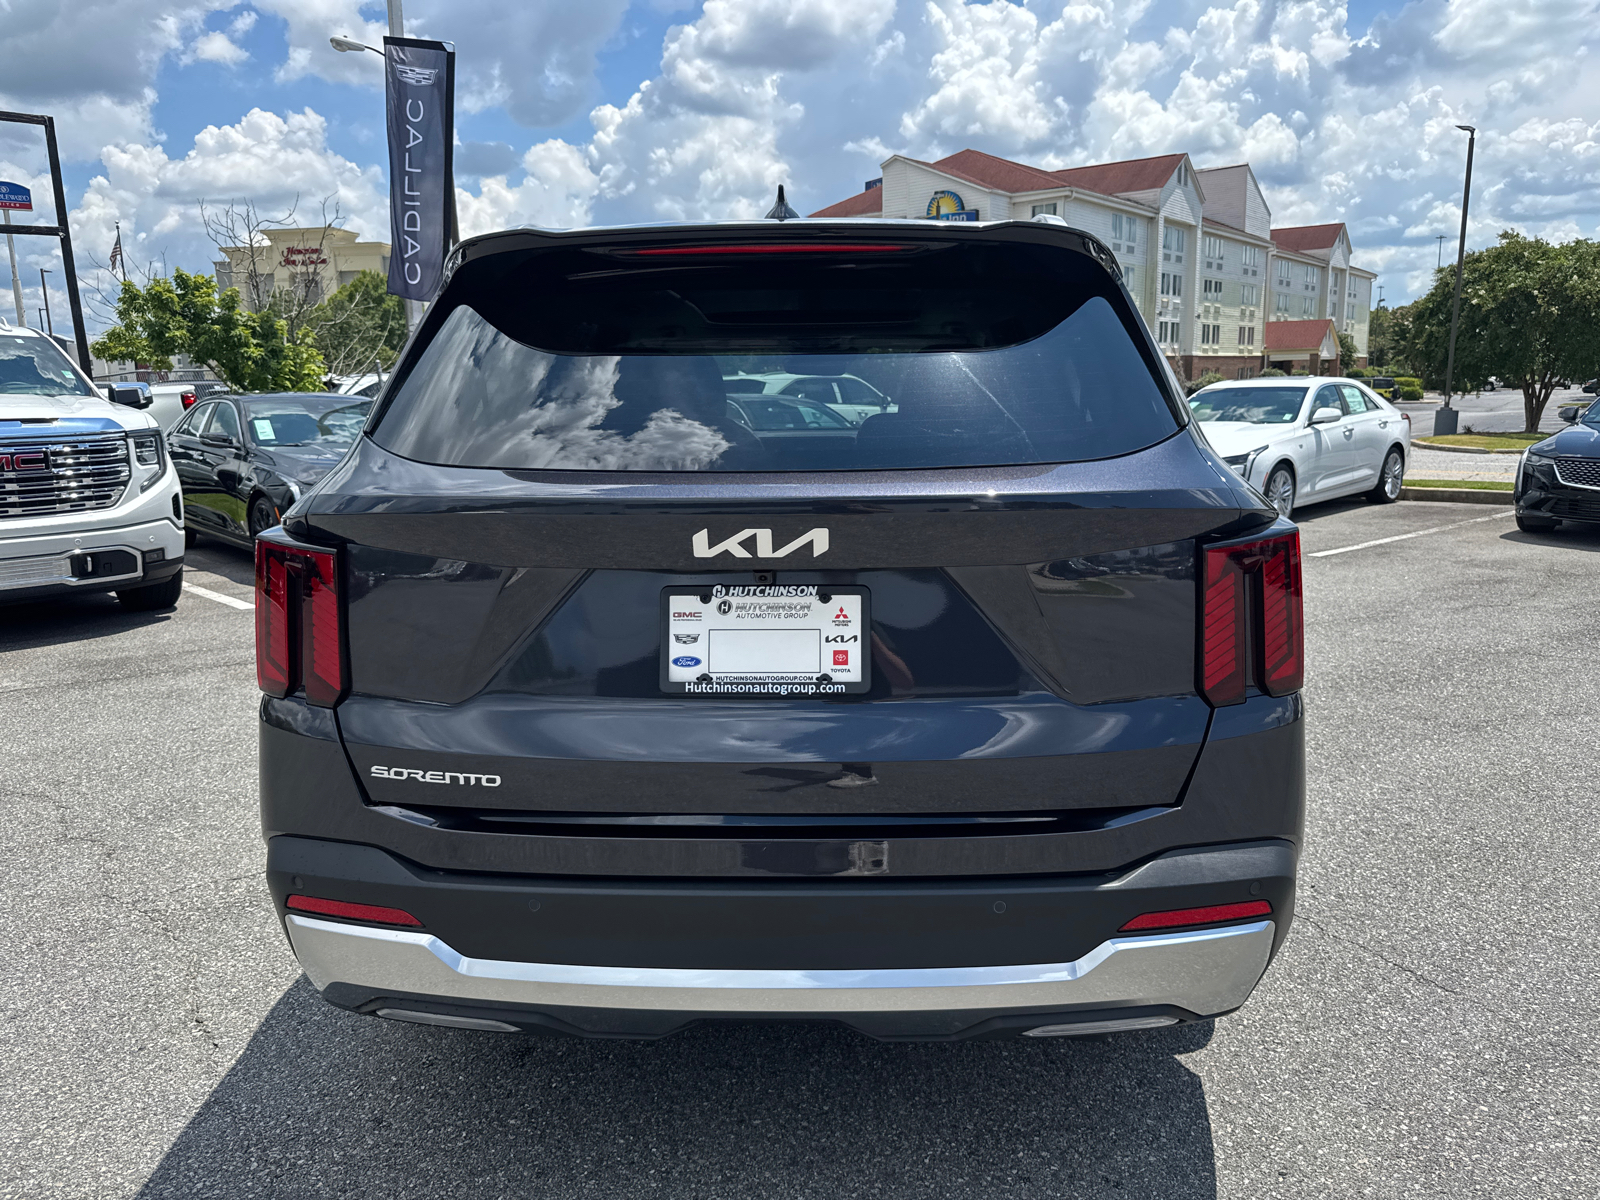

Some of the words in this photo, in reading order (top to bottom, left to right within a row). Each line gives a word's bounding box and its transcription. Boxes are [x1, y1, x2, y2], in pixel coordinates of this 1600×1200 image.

[692, 527, 830, 558] KIA
[728, 585, 818, 598] HUTCHINSON
[734, 602, 812, 613] HUTCHINSON
[825, 634, 859, 643] KIA
[677, 657, 696, 666] Ford
[685, 681, 846, 695] Hutchinsonautogroup.com
[370, 765, 502, 787] SORENTO
